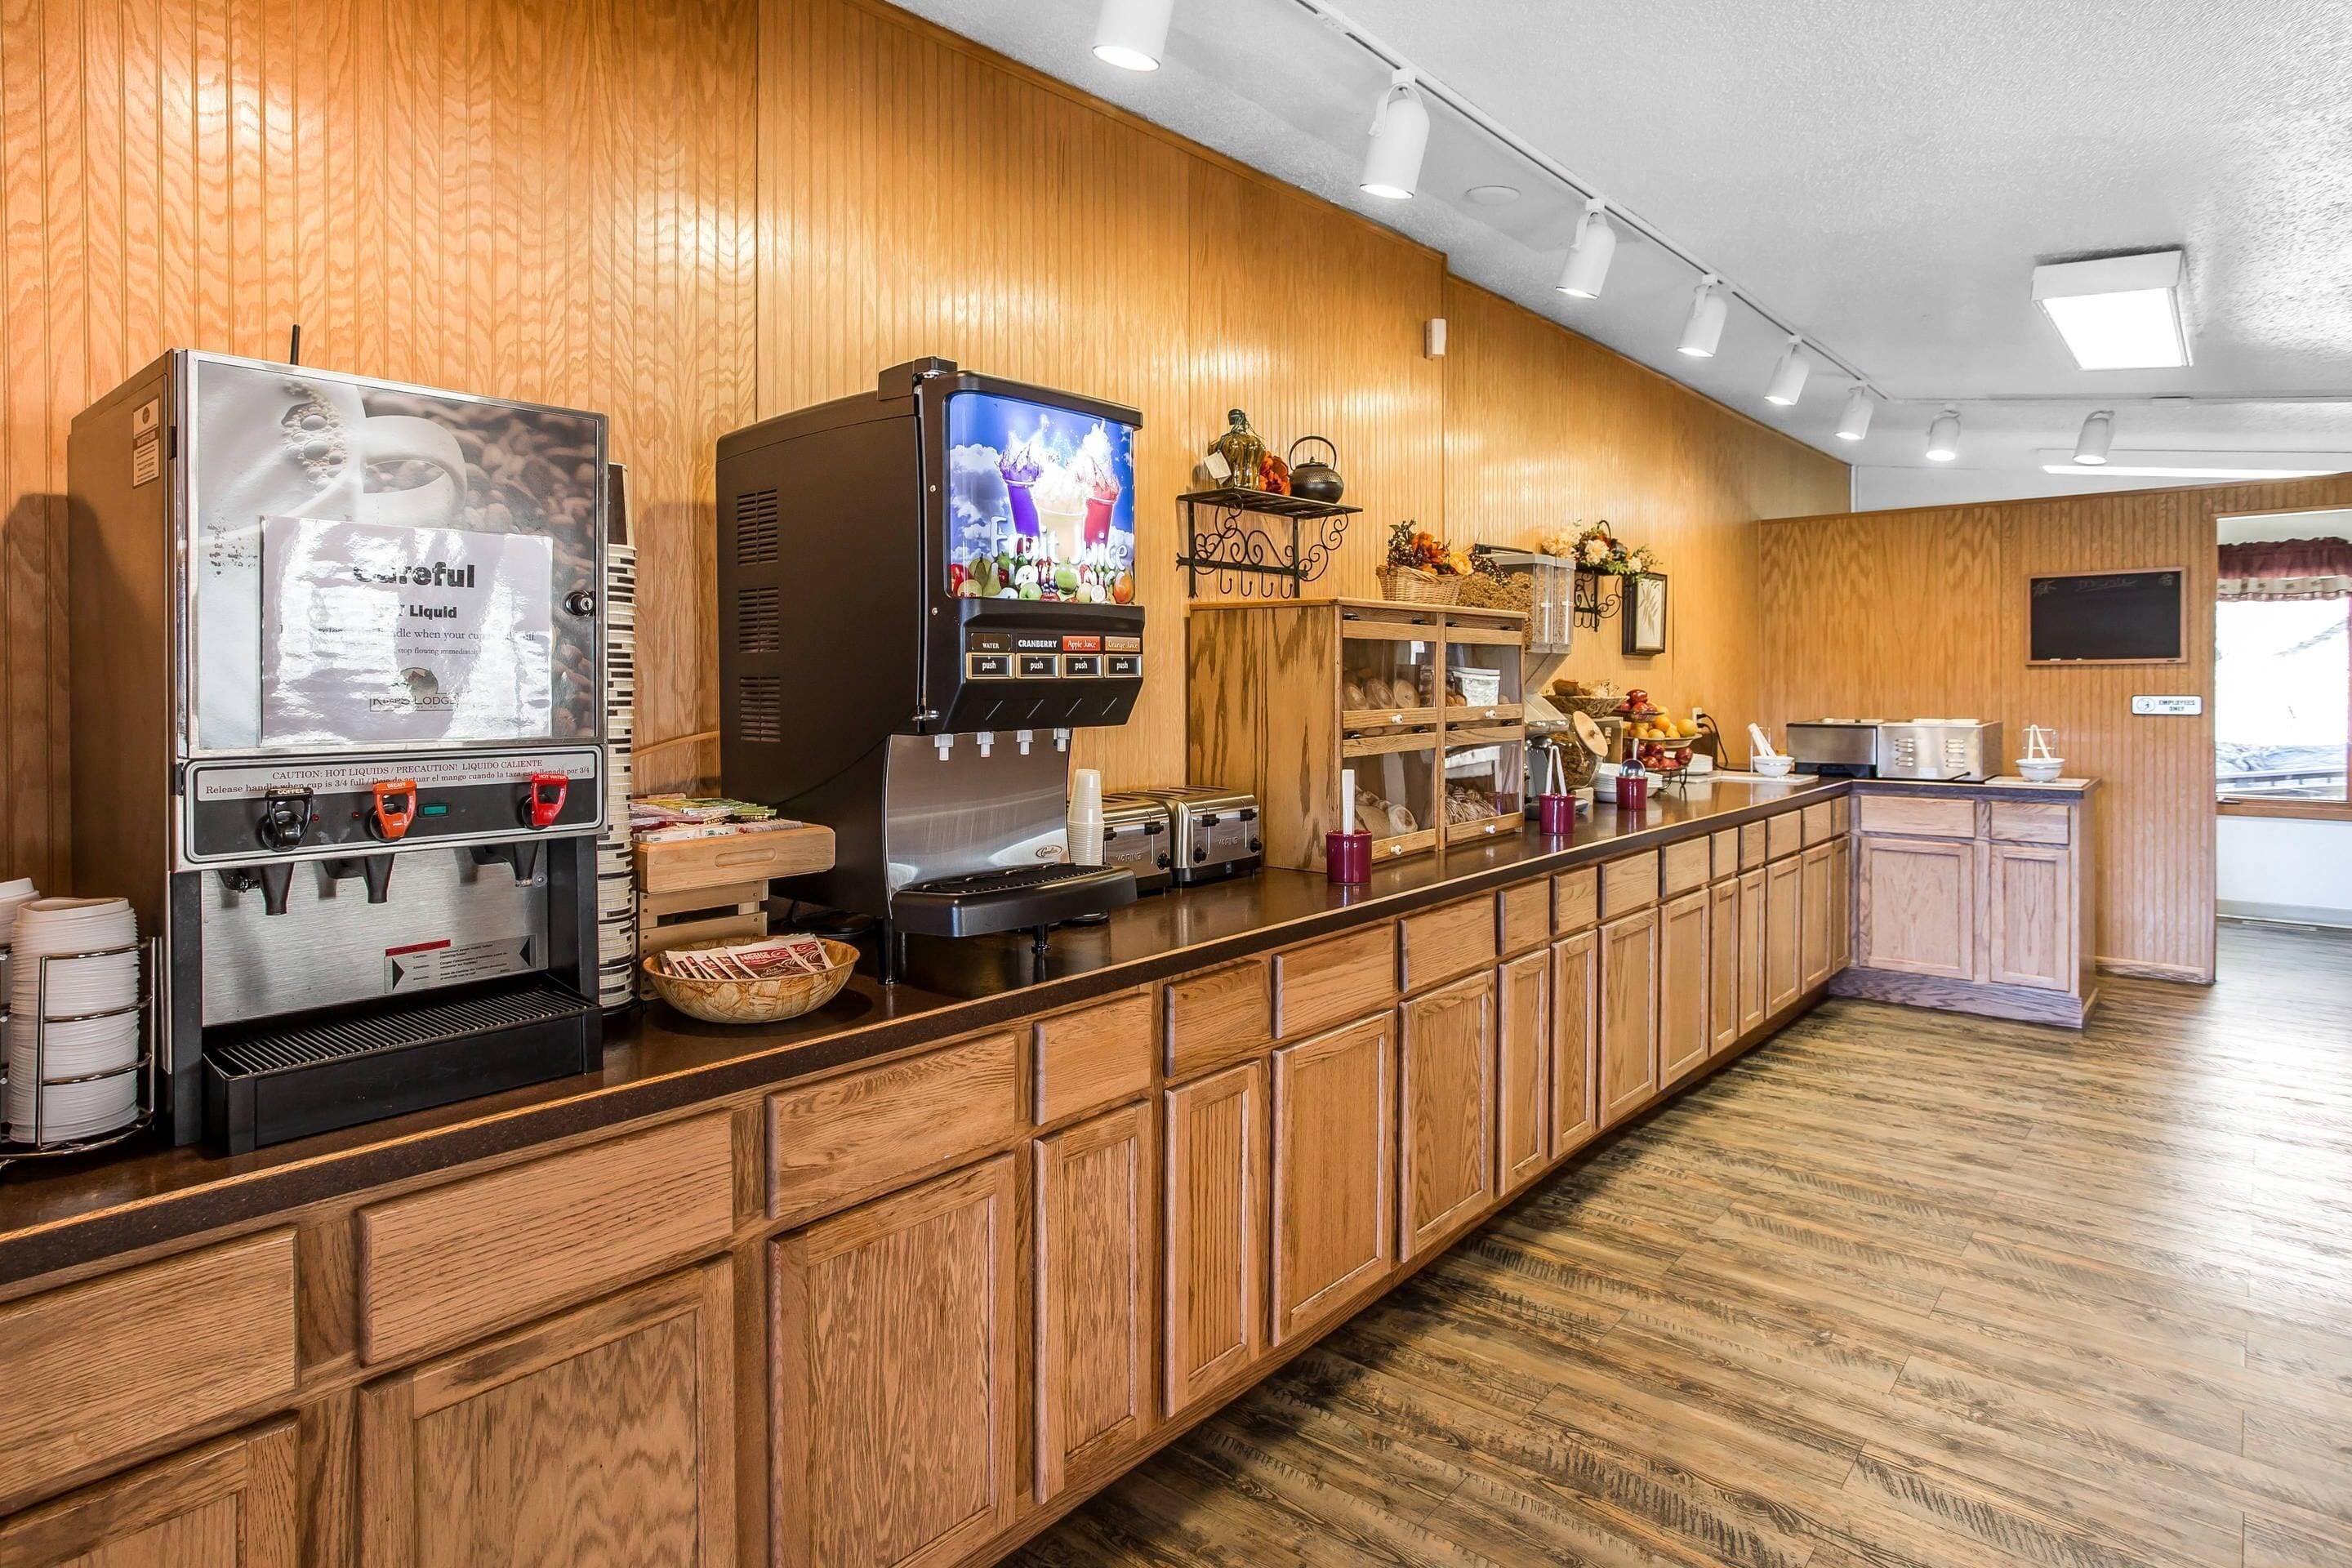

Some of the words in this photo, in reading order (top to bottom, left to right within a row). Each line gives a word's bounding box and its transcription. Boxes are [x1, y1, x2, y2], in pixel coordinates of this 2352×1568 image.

[991, 516, 1060, 564] Fruit
[1072, 523, 1128, 570] Juice
[409, 604, 457, 620] Liquid
[414, 629, 441, 639] when
[443, 631, 466, 642] your
[1018, 639, 1058, 648] CRANBERRY
[1067, 639, 1082, 648] Apple
[1084, 639, 1096, 648] Juice
[1107, 641, 1125, 650] Orange
[414, 647, 439, 657] flowing
[982, 661, 996, 670] push
[1030, 661, 1044, 670] push
[1074, 661, 1088, 670] push
[1116, 661, 1129, 670] push
[272, 770, 323, 780] CAUTION:
[326, 768, 347, 777] HOT
[349, 767, 389, 777] LIQUIDS
[396, 764, 458, 774] PRECAUTION!
[462, 761, 499, 772] LIQUIDO
[501, 760, 543, 769] CALIENTE
[206, 786, 243, 794] Release
[246, 783, 278, 792] handle
[306, 782, 323, 791] cup
[334, 779, 348, 787] 3/4
[350, 778, 365, 786] full
[441, 774, 467, 782] mango
[468, 771, 495, 780] cuando
[539, 767, 565, 775] llenada
[567, 768, 577, 776] por
